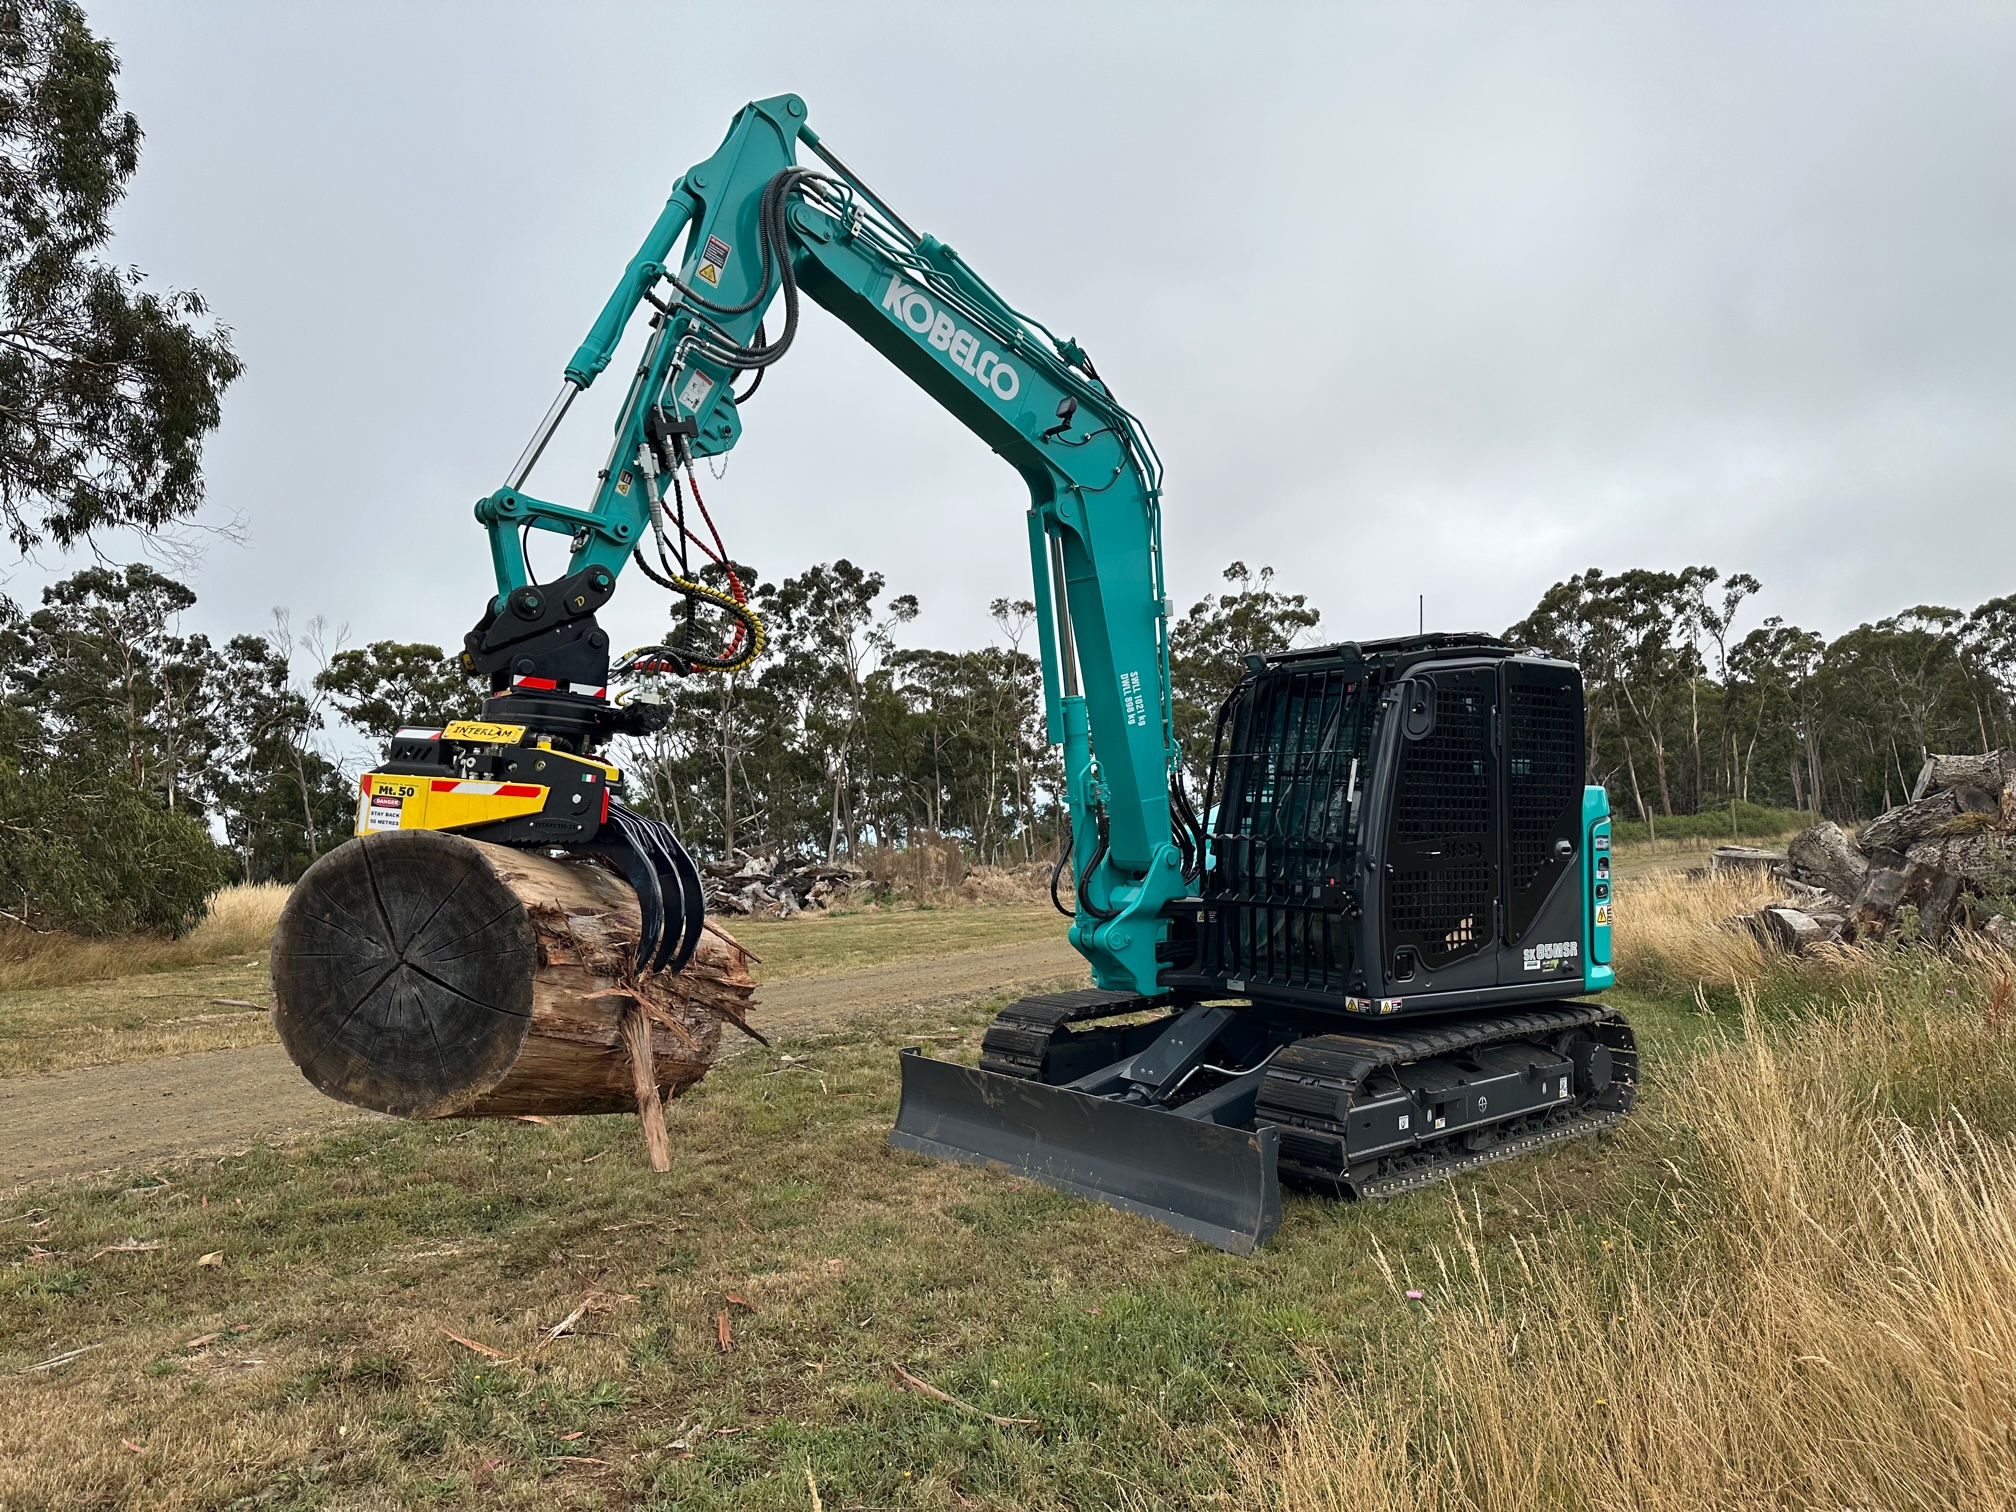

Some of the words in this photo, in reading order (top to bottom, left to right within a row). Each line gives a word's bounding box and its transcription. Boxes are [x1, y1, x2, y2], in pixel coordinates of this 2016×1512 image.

[881, 274, 1020, 401] KOBELCO
[1130, 671, 1141, 694] SWLL
[1120, 673, 1131, 696] DWLL
[1127, 713, 1136, 725] kg
[1134, 694, 1145, 714] 1021
[453, 726, 513, 737] INTERLAM
[1138, 715, 1146, 727] kg
